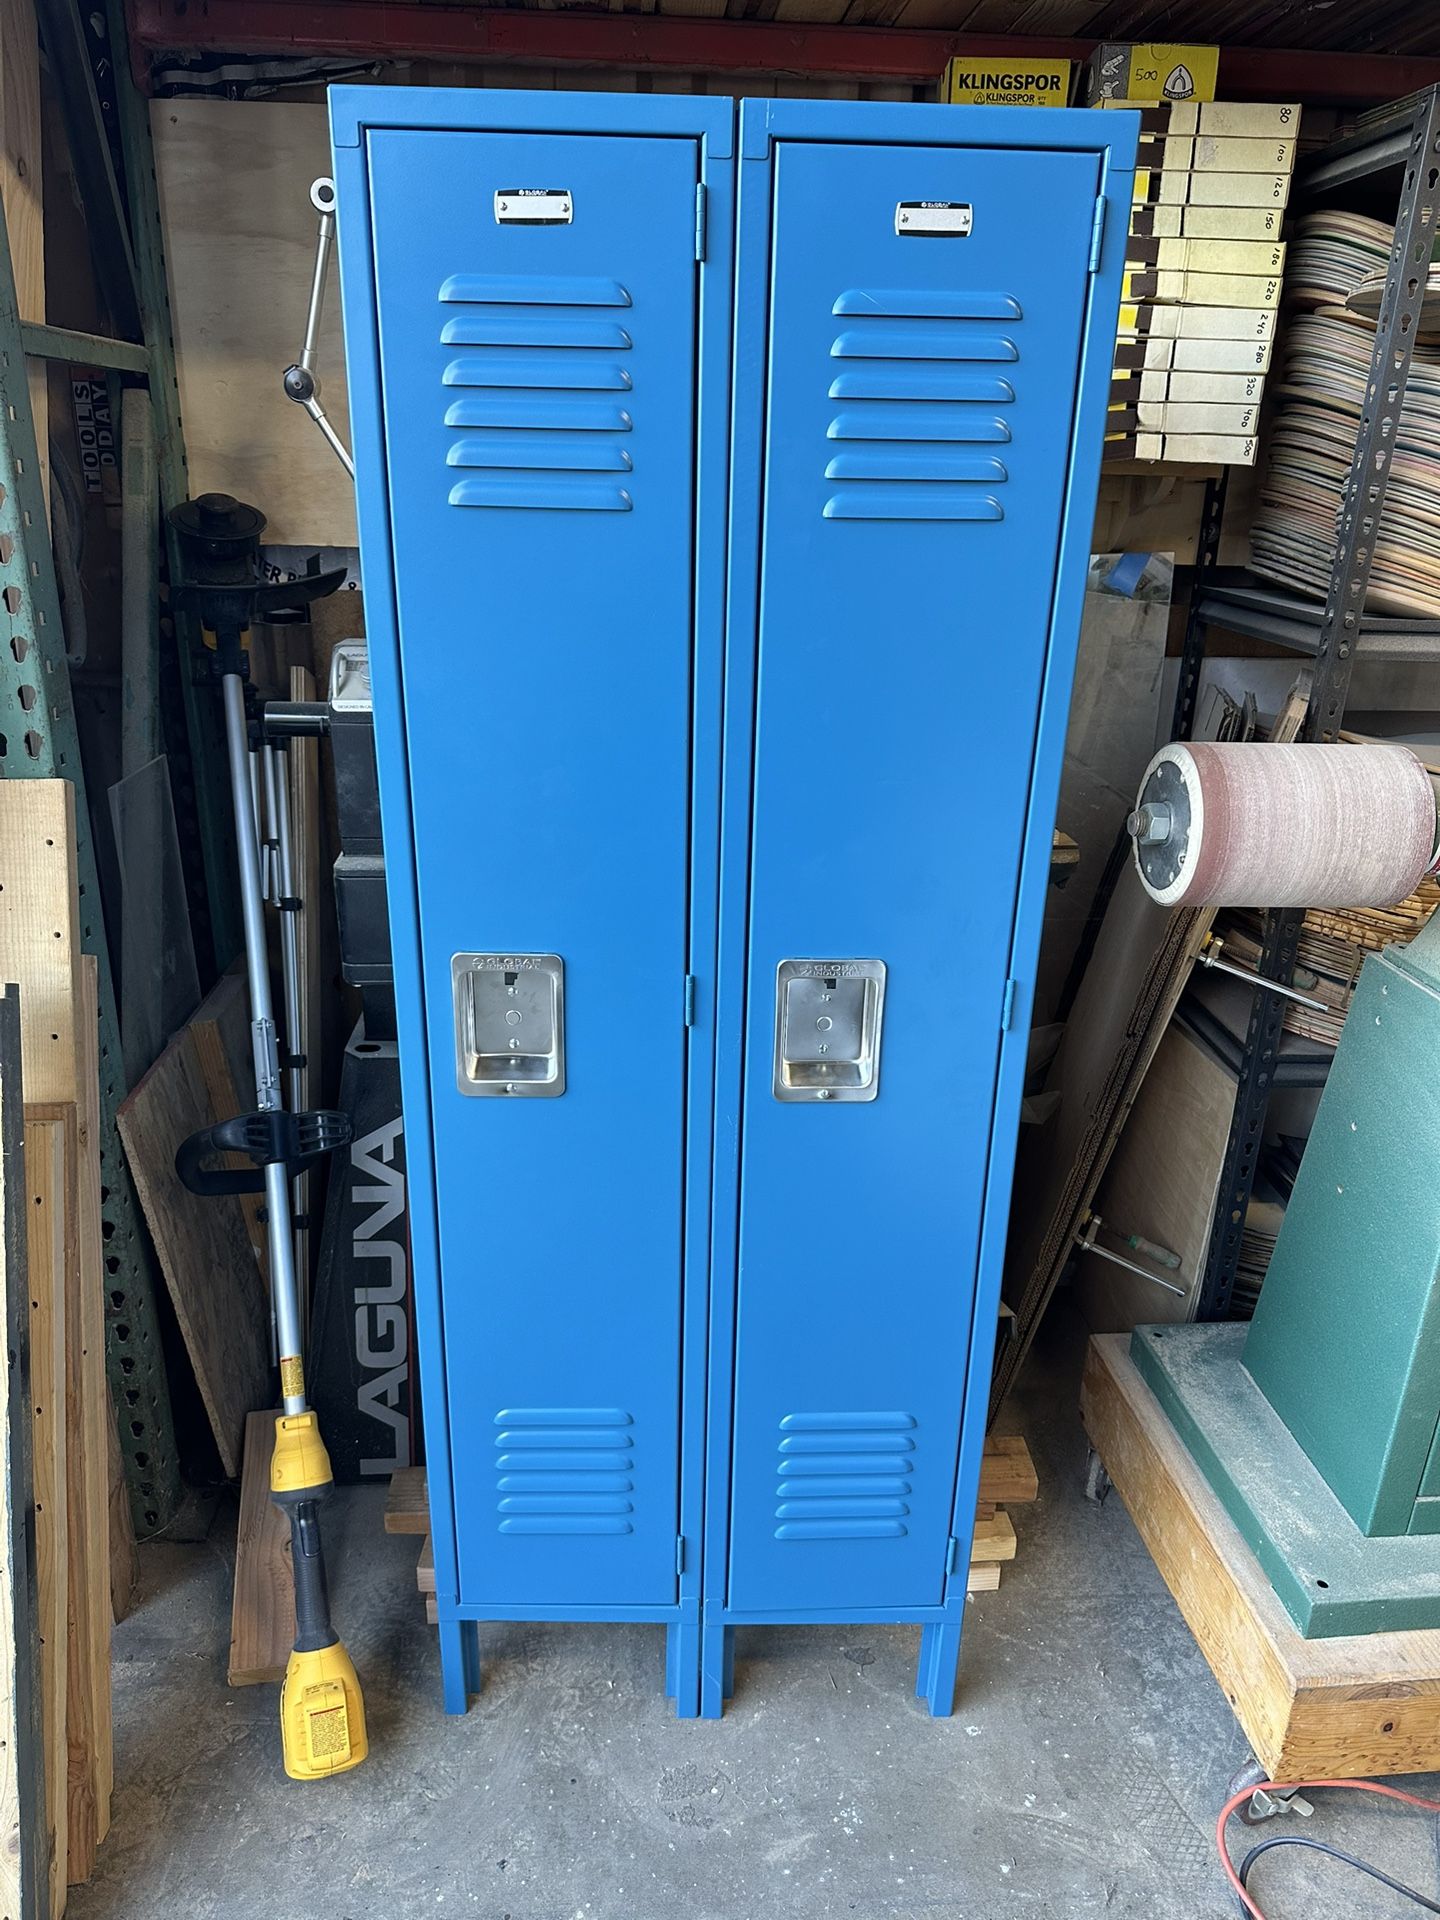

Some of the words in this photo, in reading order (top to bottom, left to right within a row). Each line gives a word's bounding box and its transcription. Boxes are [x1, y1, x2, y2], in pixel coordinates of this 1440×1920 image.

[959, 73, 1061, 91] KLINGSPOR
[1135, 68, 1158, 81] 500
[986, 92, 1035, 103] KLINGSPOR
[1163, 89, 1193, 99] KLINGSPOR
[1280, 107, 1292, 124] 80
[1277, 144, 1287, 162] 100
[1273, 177, 1283, 197] 120
[1265, 212, 1274, 230] 150
[1271, 247, 1280, 266] 180
[1265, 280, 1276, 300] 220
[1256, 313, 1269, 334] 240
[1255, 345, 1266, 364] 280
[1246, 377, 1257, 396] 320
[1241, 408, 1253, 428] 400
[74, 384, 102, 489] TOOLS
[1243, 439, 1254, 457] 500
[351, 1115, 410, 1476] LAGUNA
